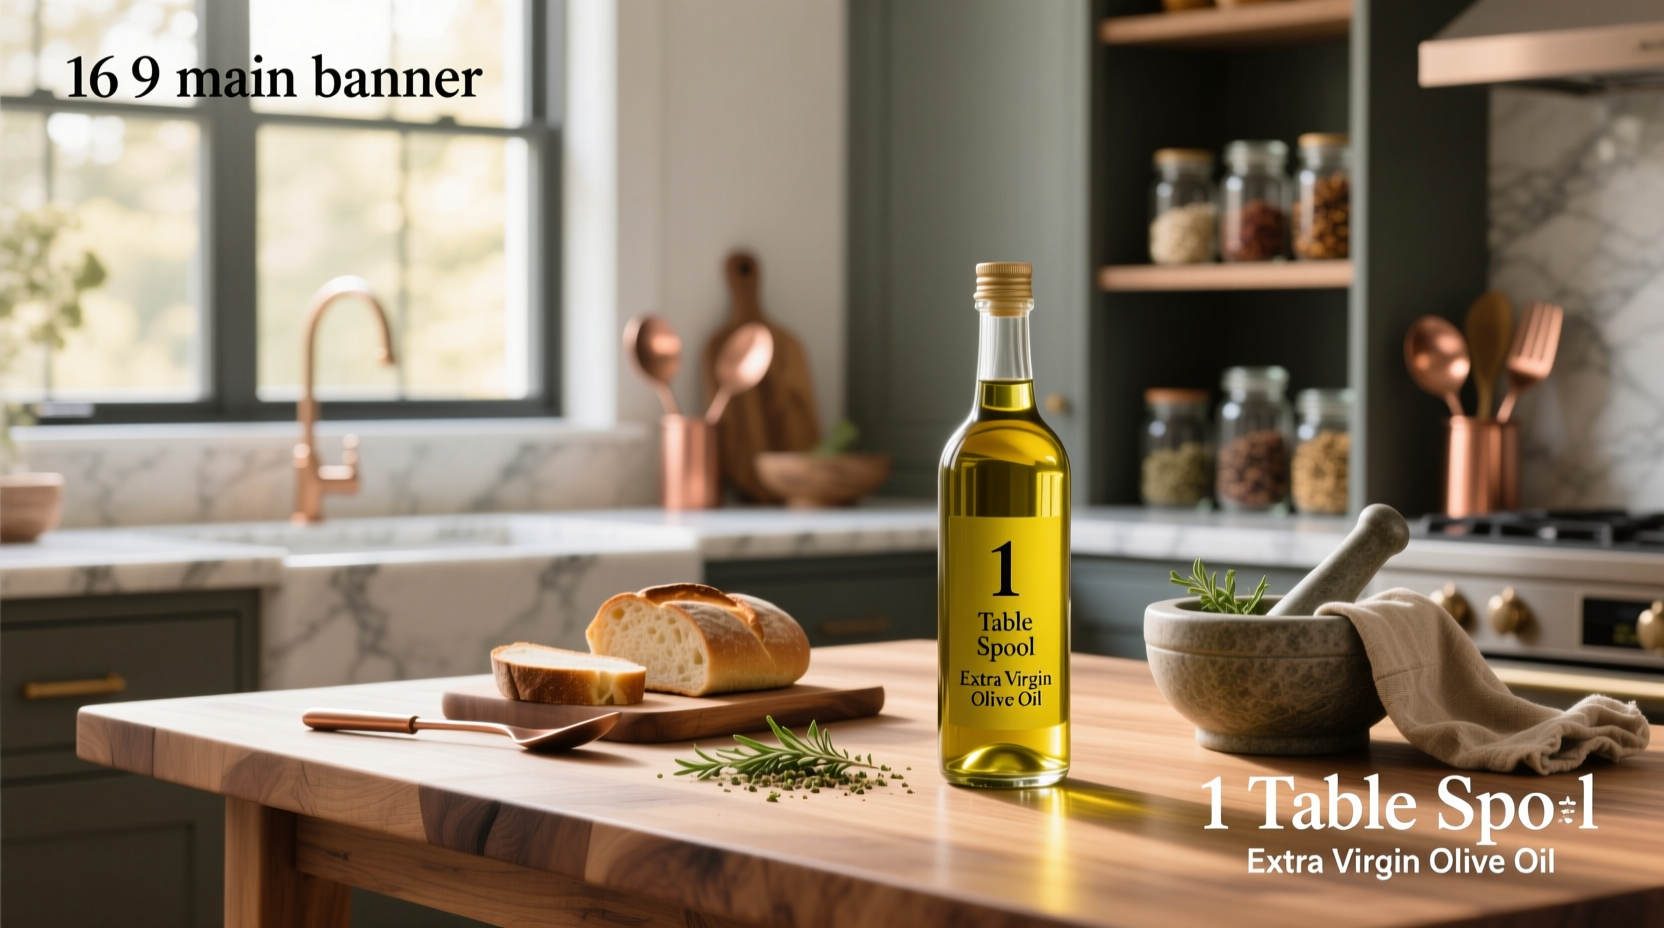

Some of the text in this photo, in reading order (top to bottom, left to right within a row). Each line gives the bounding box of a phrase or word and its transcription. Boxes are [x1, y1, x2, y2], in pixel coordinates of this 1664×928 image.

[991, 540, 1020, 597] 1
[977, 610, 1033, 632] Table
[977, 636, 1036, 662] Spool
[960, 670, 1052, 690] Extra Virgin
[971, 690, 1042, 707] Olive Oil
